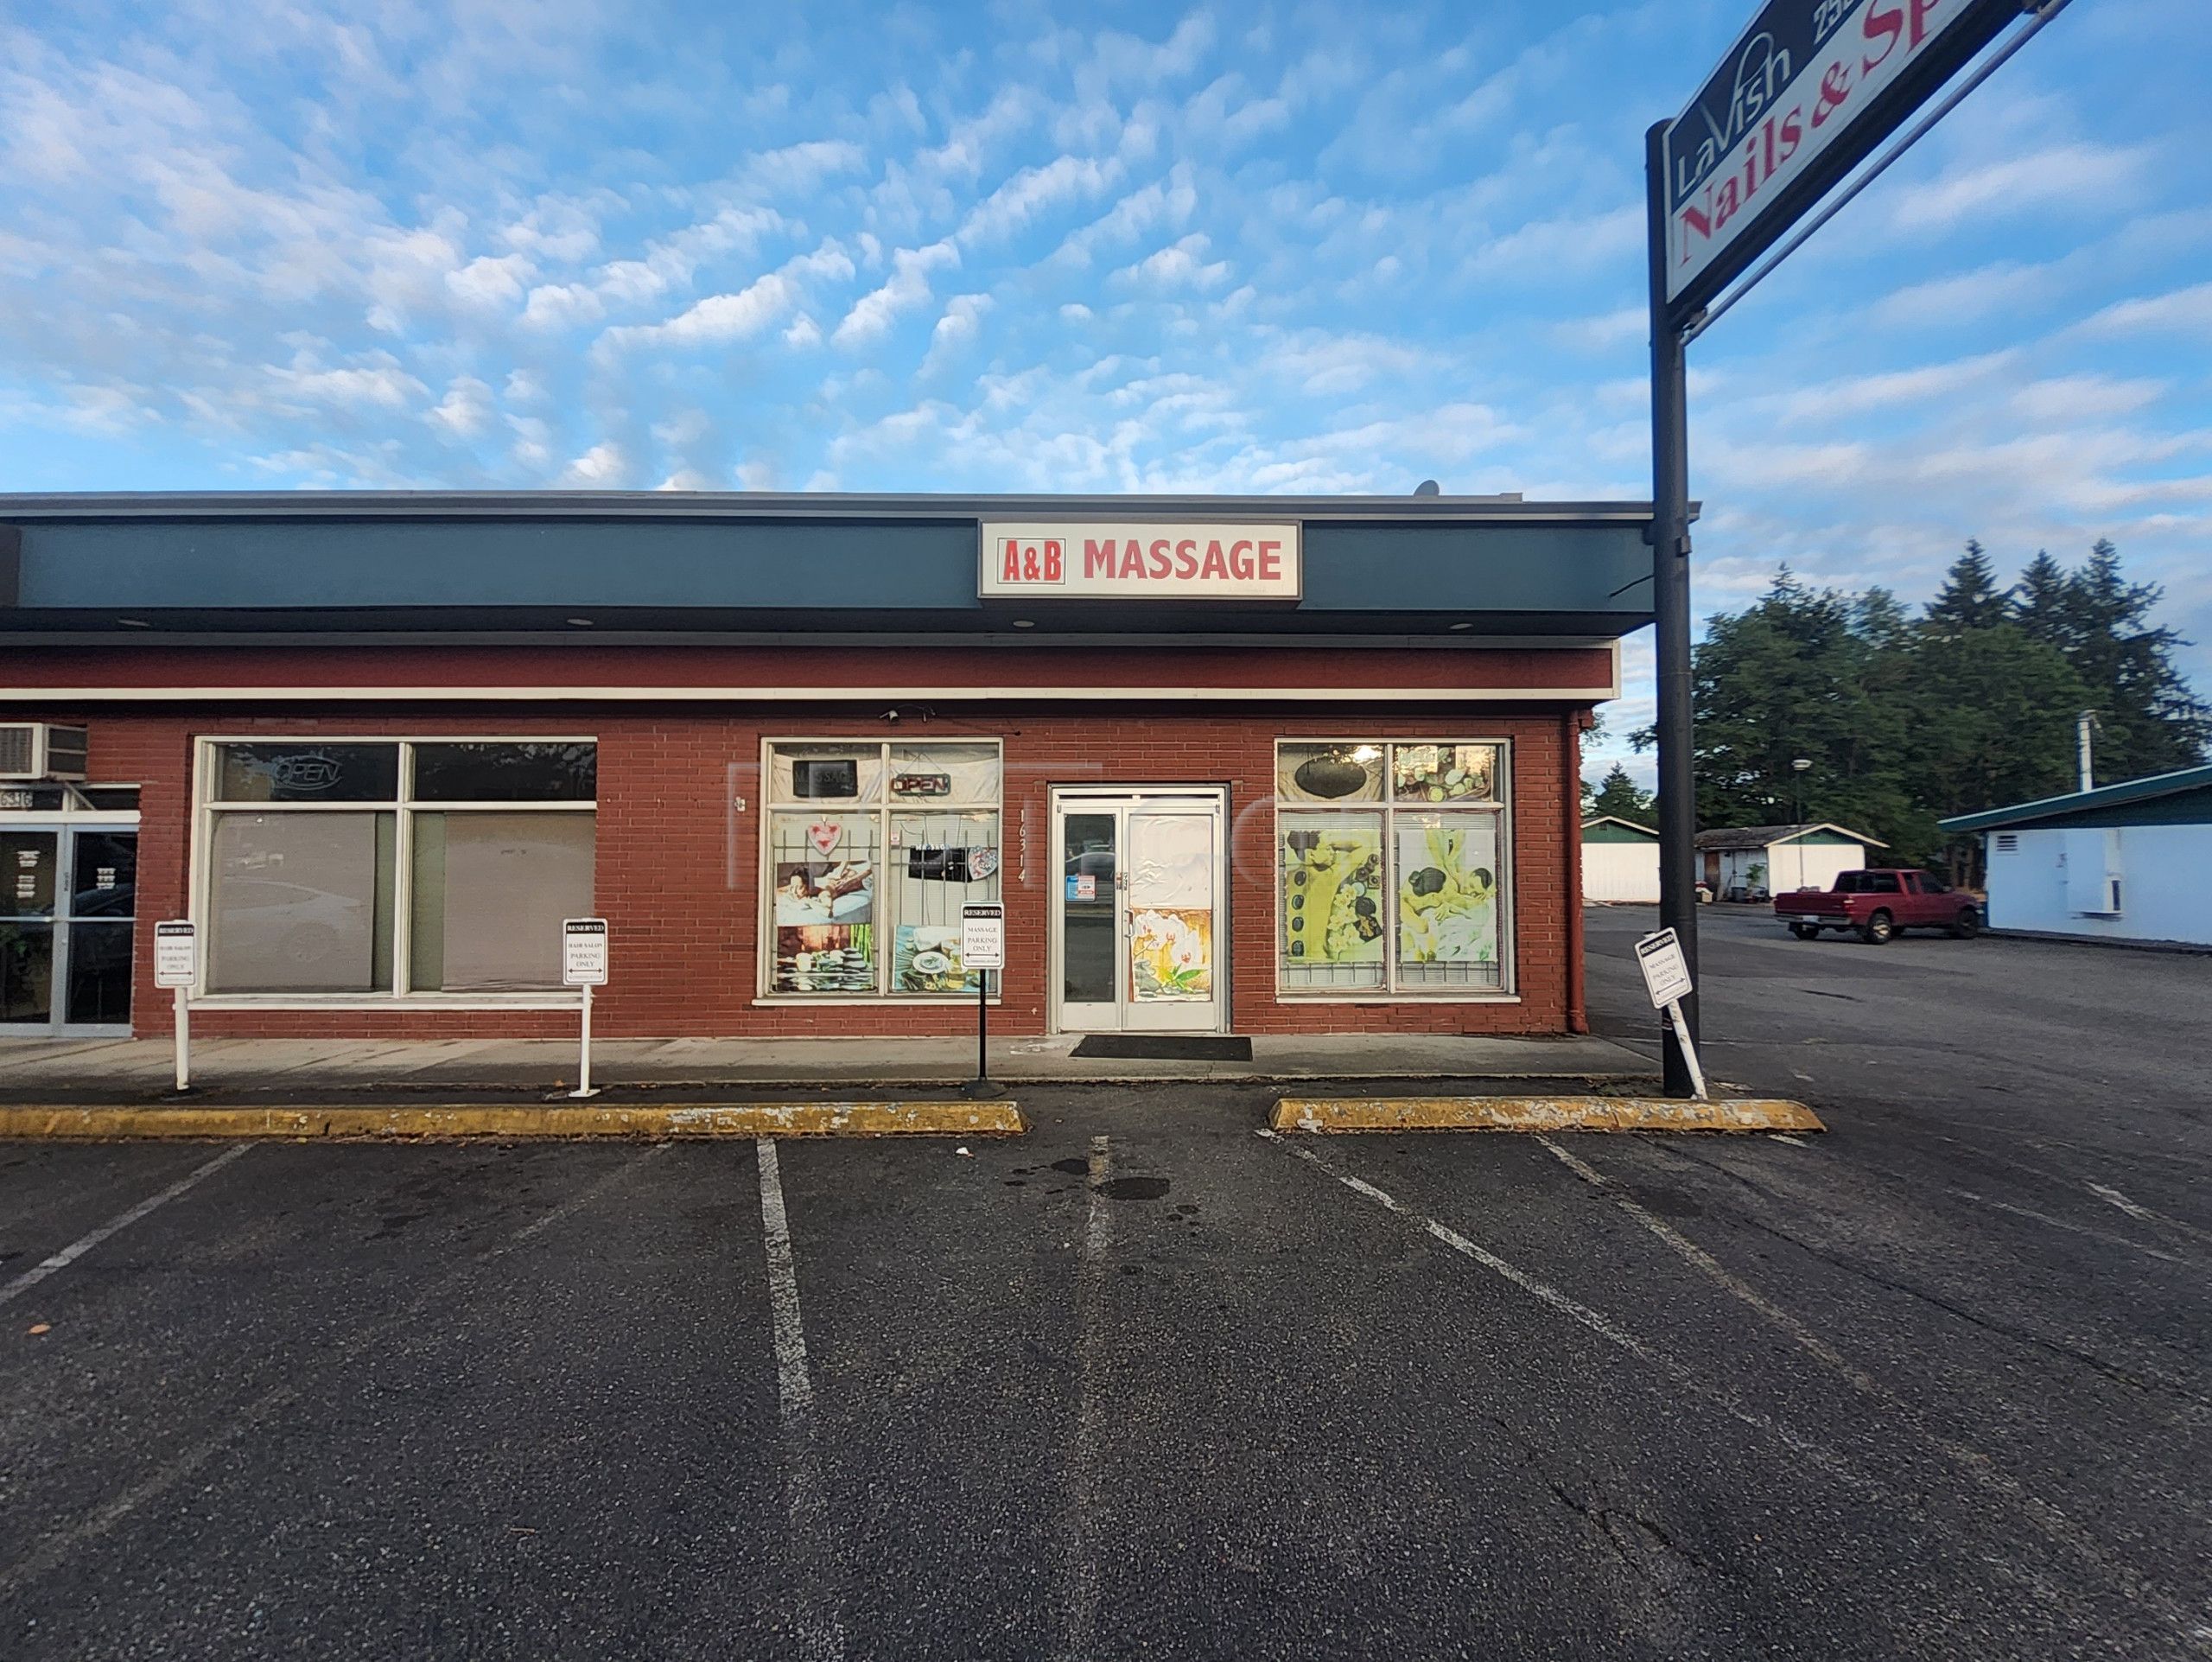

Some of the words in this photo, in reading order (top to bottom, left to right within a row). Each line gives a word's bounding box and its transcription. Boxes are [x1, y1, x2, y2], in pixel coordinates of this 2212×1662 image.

[1679, 103, 1802, 268] Nails
[1002, 539, 1063, 582] A&B
[1084, 538, 1281, 581] MASSAGE
[891, 776, 946, 793] OPEN
[1018, 809, 1027, 882] 16314
